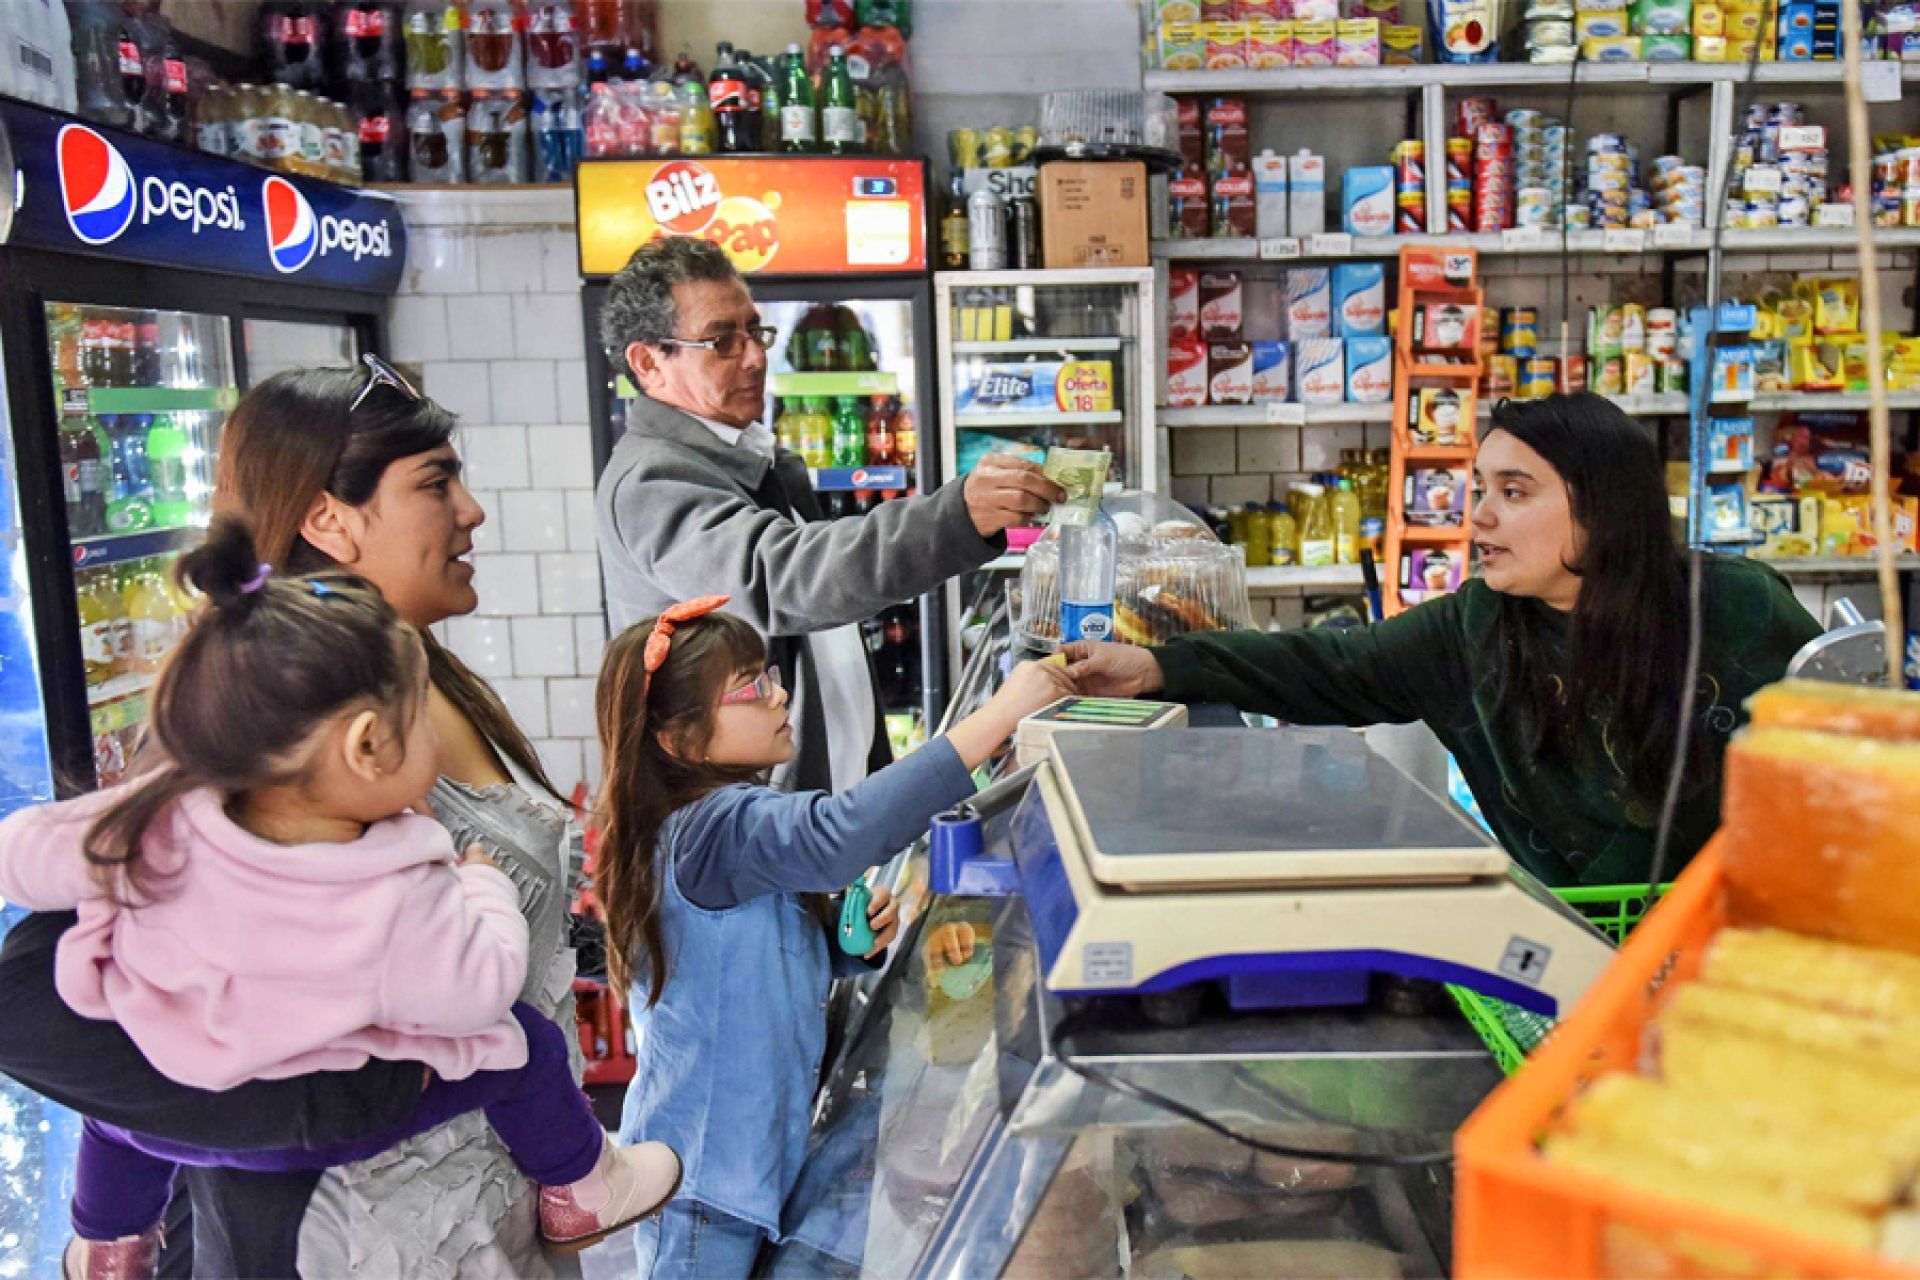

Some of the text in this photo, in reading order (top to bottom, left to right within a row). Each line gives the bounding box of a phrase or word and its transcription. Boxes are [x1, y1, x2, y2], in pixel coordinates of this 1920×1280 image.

[141, 176, 245, 233] pepsi
[646, 170, 722, 223] Bilz
[319, 215, 392, 261] pepsi
[1073, 396, 1094, 412] 18
[1082, 620, 1106, 632] vital
